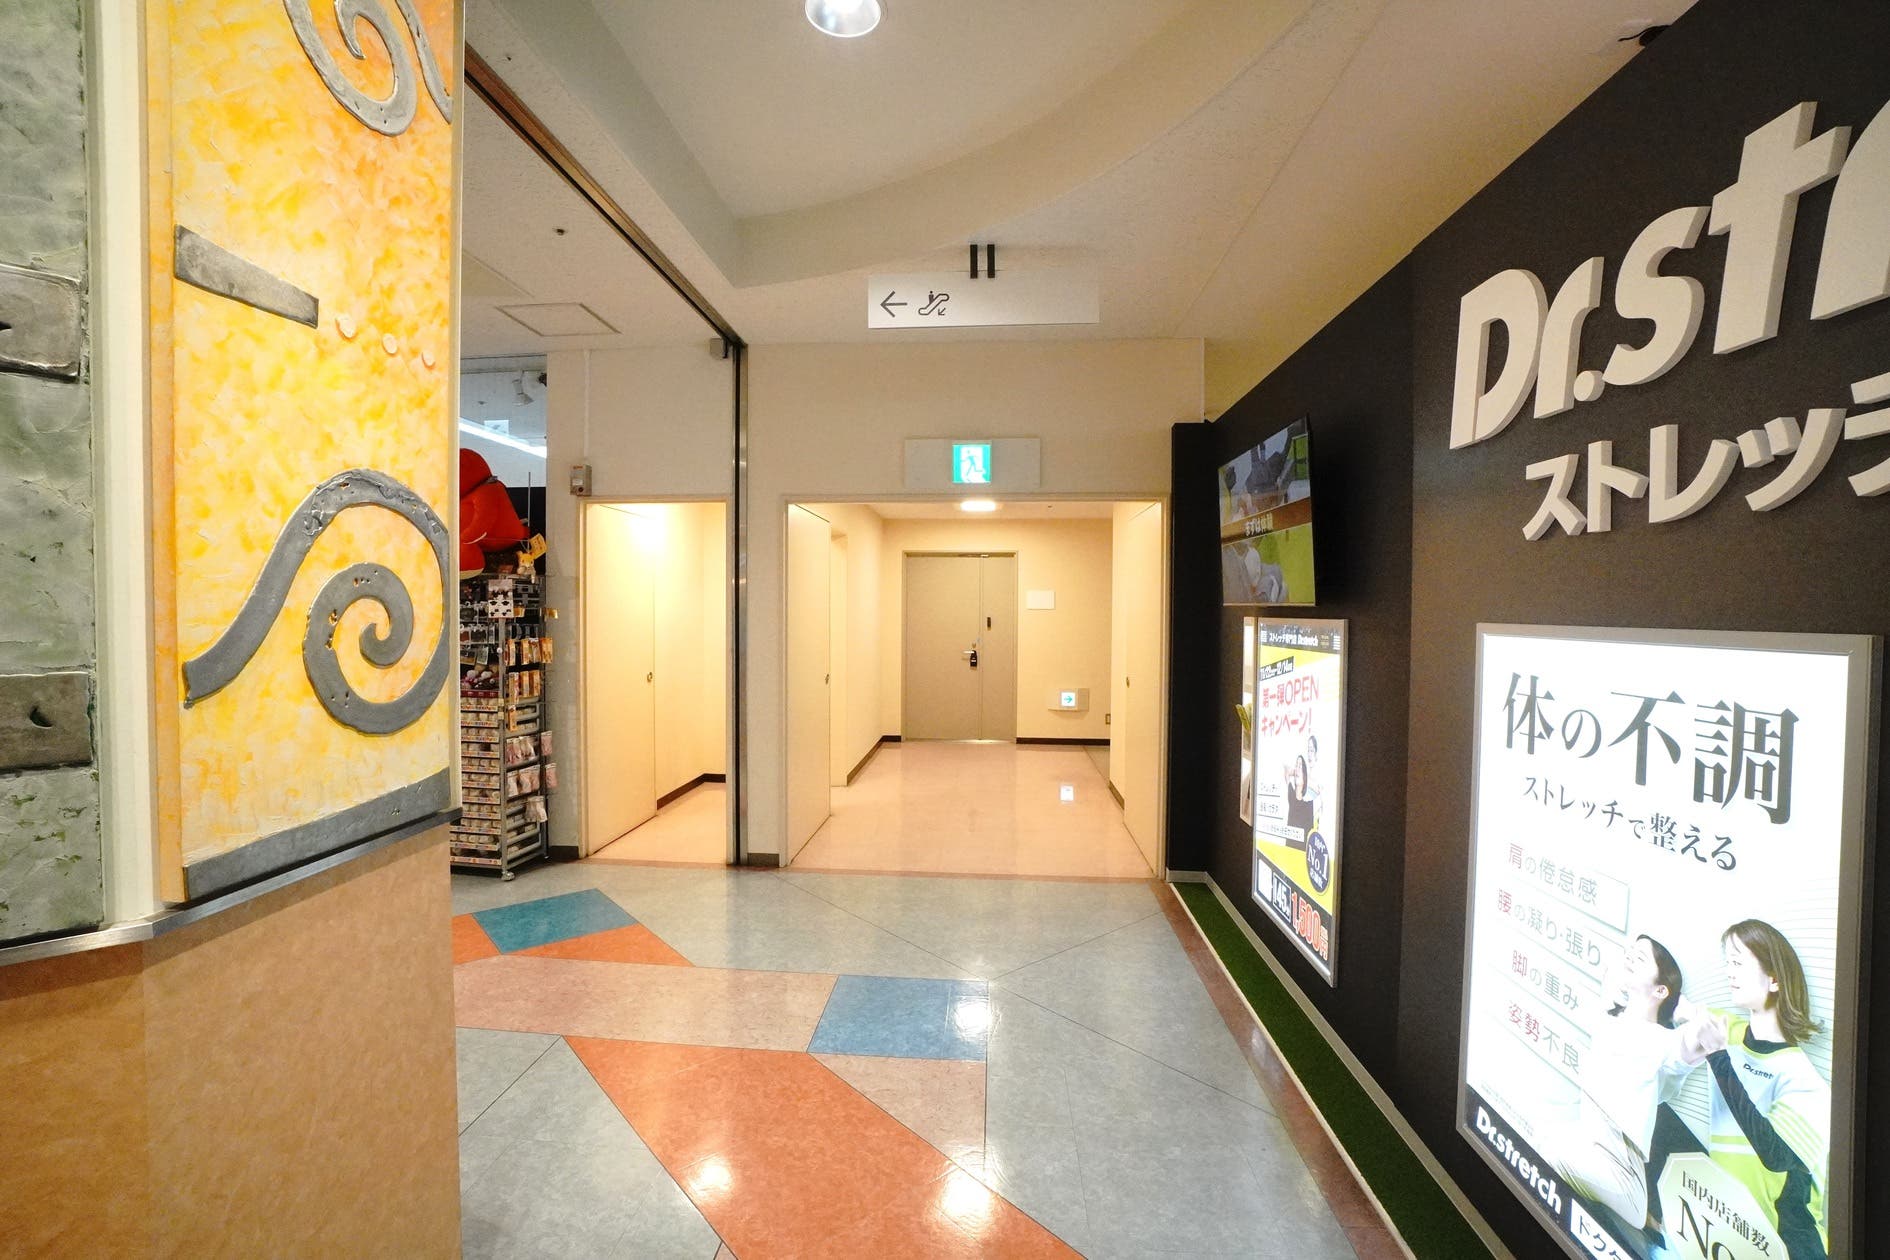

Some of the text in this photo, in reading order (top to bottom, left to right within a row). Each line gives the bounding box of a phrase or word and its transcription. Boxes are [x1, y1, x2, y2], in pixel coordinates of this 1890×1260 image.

[1501, 672, 1800, 825] 体の不調
[1522, 774, 1739, 872] ストレッチで整える
[1508, 842, 1599, 906] 肩の倦怠感
[1511, 950, 1580, 1011] 脚の重み
[1507, 1000, 1580, 1075] 姿勢不良
[1476, 1105, 1562, 1215] Dr.stretch
[1682, 1170, 1770, 1257] 国内店舗数
